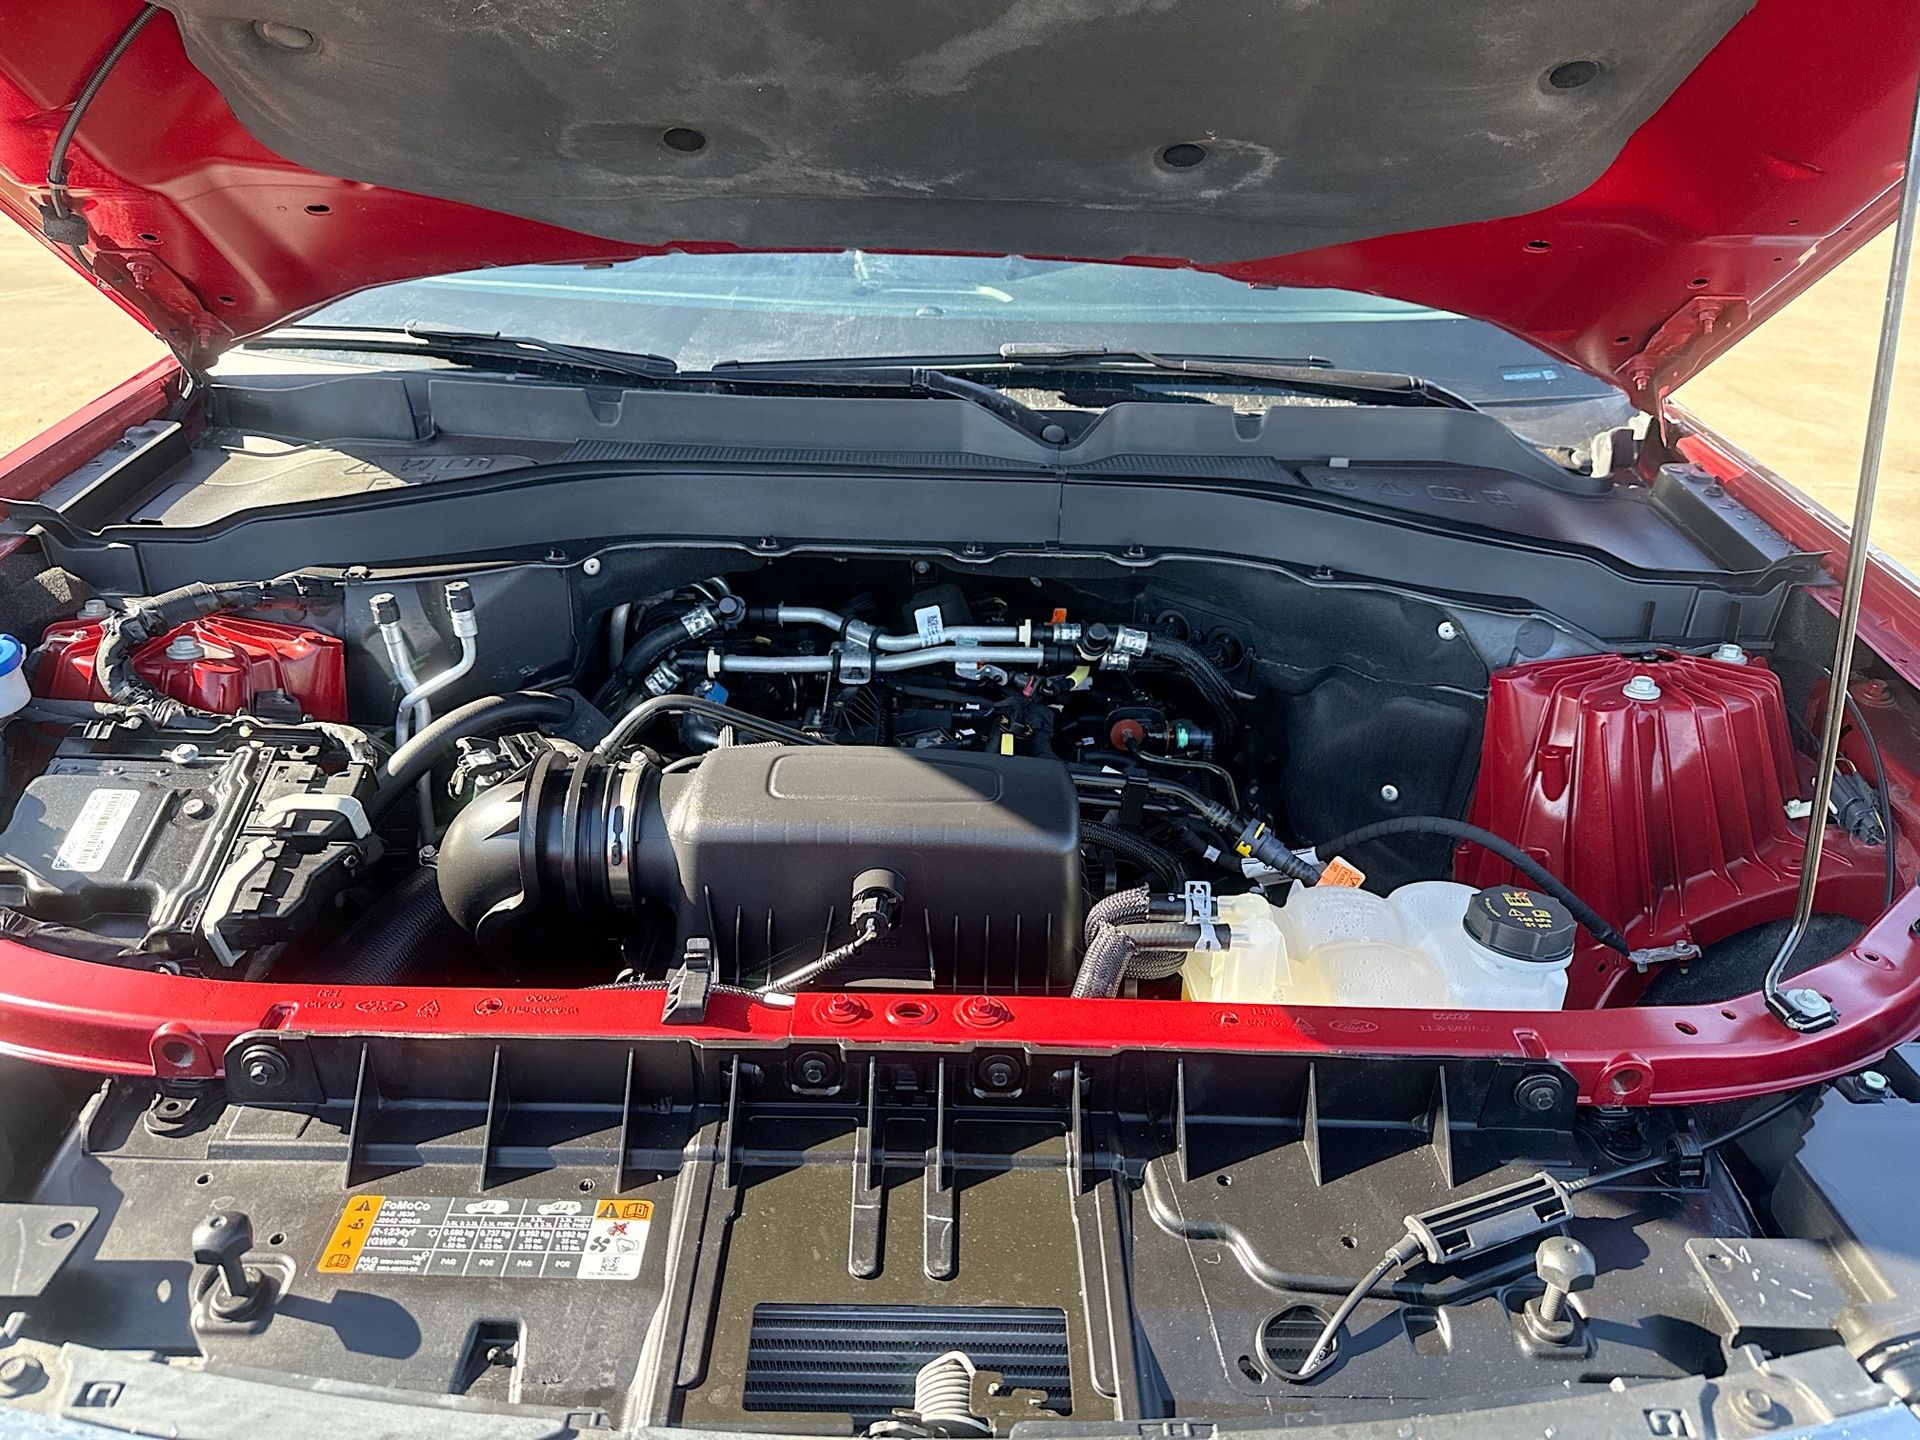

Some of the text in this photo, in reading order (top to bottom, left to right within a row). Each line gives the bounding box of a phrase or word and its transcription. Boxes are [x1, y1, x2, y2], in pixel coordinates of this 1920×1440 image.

[382, 1200, 431, 1211] FoMoCo
[371, 1227, 418, 1237] R-1234yf
[464, 1229, 475, 1238] kg
[500, 1230, 512, 1239] kg
[540, 1230, 550, 1239] kg
[577, 1231, 587, 1240] kg
[366, 1237, 409, 1247] (GWP 4)
[358, 1256, 379, 1264] PAG
